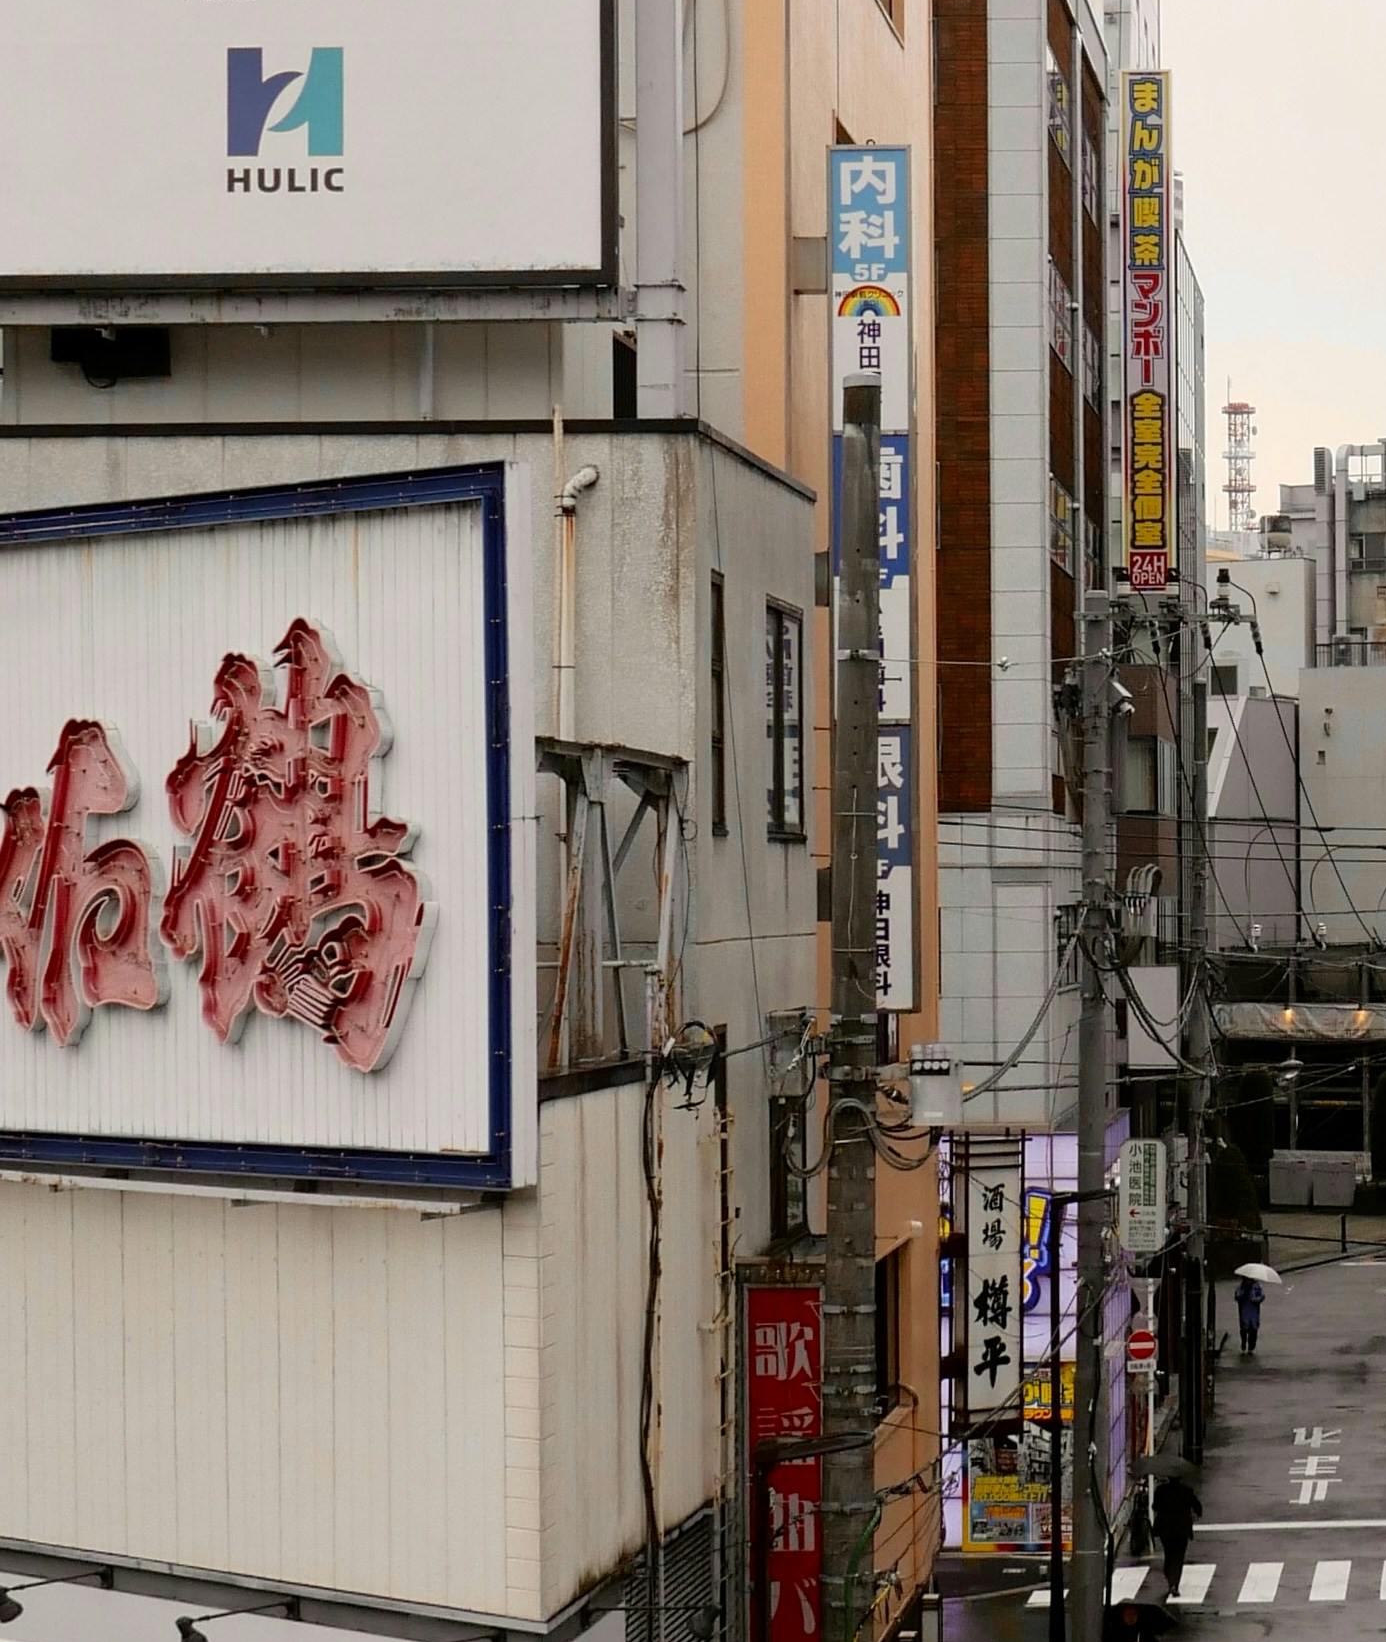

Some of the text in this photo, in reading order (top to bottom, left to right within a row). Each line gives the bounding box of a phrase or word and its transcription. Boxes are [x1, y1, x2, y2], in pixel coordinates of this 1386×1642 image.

[227, 167, 344, 193] HULIC
[838, 155, 899, 258] 内科
[854, 263, 885, 280] 5F
[1132, 272, 1162, 385] マンボー
[1132, 556, 1165, 572] 24H
[1132, 572, 1165, 584] OPEN
[981, 1183, 1006, 1251] 酒場
